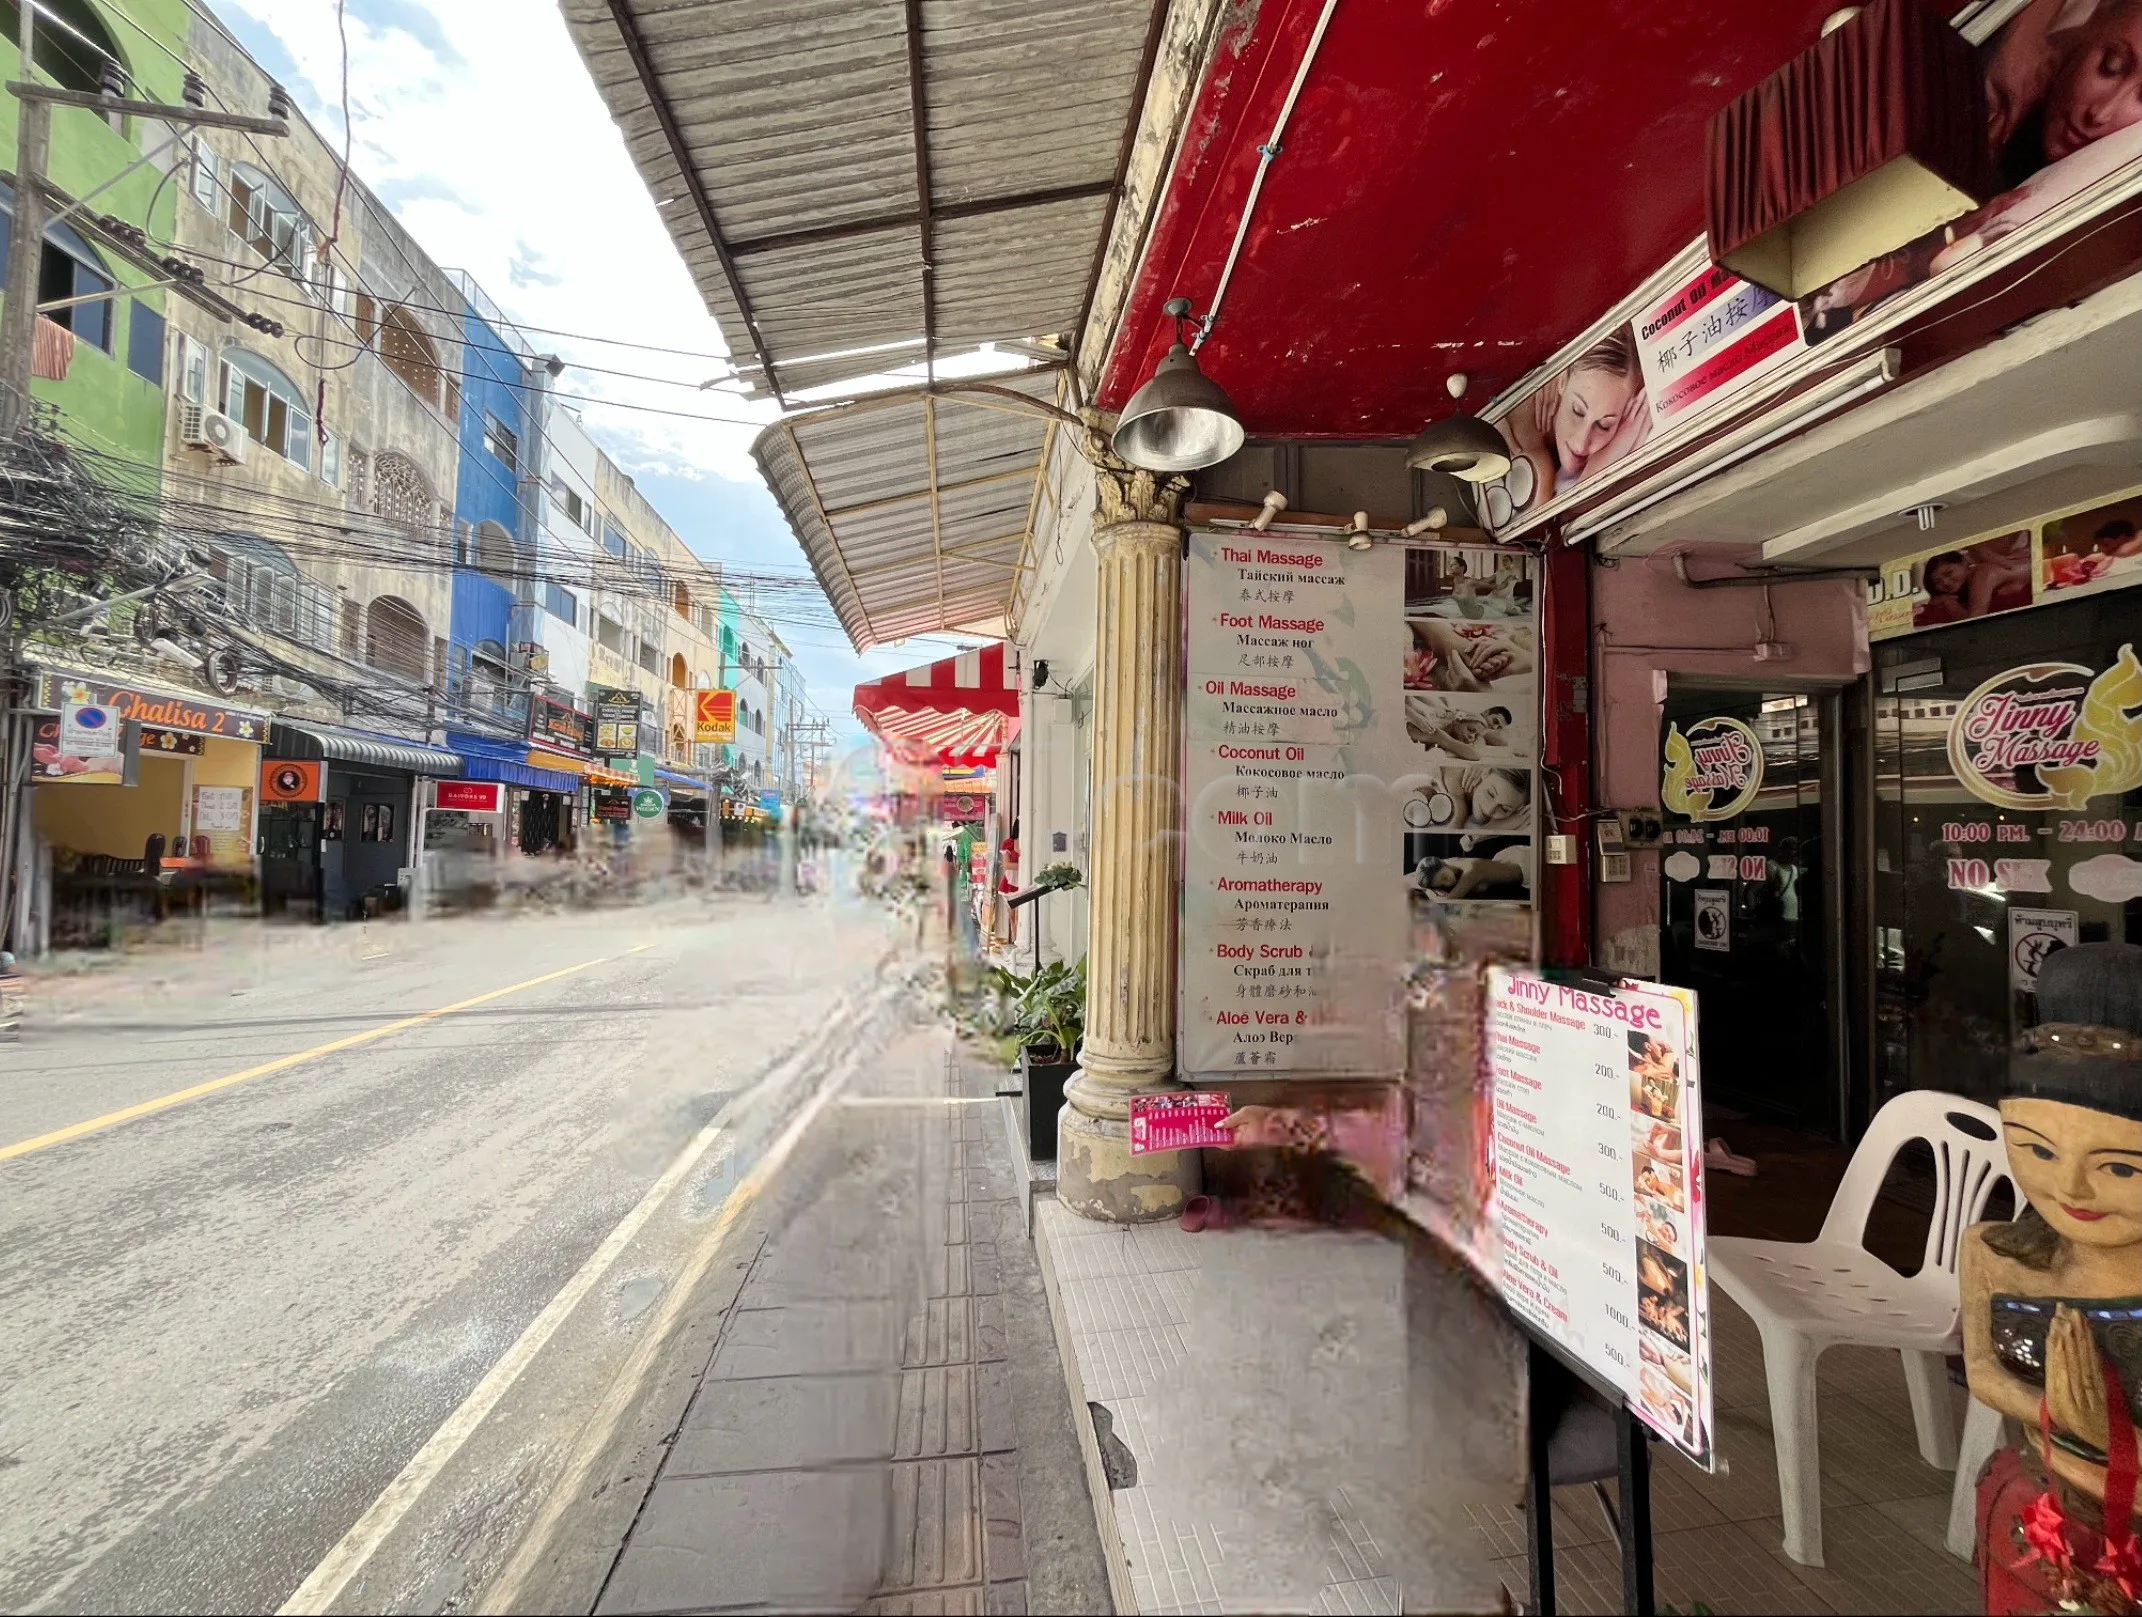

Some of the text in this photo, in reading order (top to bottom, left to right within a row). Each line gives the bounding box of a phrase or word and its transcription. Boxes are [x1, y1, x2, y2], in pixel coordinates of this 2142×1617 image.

[1641, 298, 1687, 340] Coconut
[1221, 547, 1323, 569] Thai Massage
[1238, 568, 1345, 585] Тайский массаж
[1240, 588, 1294, 604] 泰式按摩
[1220, 613, 1324, 633] Foot Massage
[1237, 634, 1315, 649] Массаж ног
[1238, 653, 1294, 668] 足部按摩
[1205, 680, 1296, 700] Oil Massage
[109, 690, 226, 733] Chalisa 2
[1222, 701, 1338, 718] Массажное масло
[1968, 695, 2073, 739] Jinny
[697, 722, 731, 732] Kodak
[1223, 720, 1280, 737] 精油按摩
[1219, 744, 1304, 760] Coconut Oil
[1976, 735, 2100, 770] Massage
[1235, 765, 1345, 780] Кокосовое масло
[1236, 785, 1279, 799] 椰子油
[1218, 811, 1273, 826] Milk Oil
[1235, 831, 1333, 845] Молоко Масло
[1942, 823, 1990, 842] 10:00
[2058, 820, 2127, 842] 24:00
[1236, 850, 1278, 865] 牛奶油
[1948, 859, 1989, 889] NO
[1217, 877, 1322, 895] Aromatherapy
[1234, 898, 1329, 913] Ароматерапия
[1236, 917, 1292, 931] 芳香療法
[1217, 944, 1254, 961] Body
[1260, 944, 1303, 959] Scrub
[1233, 965, 1275, 979] Скраб
[1278, 967, 1301, 977] для
[1508, 975, 1662, 1030] Jinny Massage
[1217, 1011, 1249, 1025] Aloe
[1255, 1011, 1289, 1025] Vera
[1295, 1010, 1307, 1025] &
[1517, 1004, 1548, 1020] Shoulder
[1549, 1011, 1586, 1031] Massage
[1233, 1031, 1265, 1043] Алоэ
[1509, 1035, 1541, 1055] Massage
[1510, 1069, 1542, 1090] Massage
[1506, 1101, 1537, 1124] Massage
[1536, 1149, 1571, 1175] Massage
